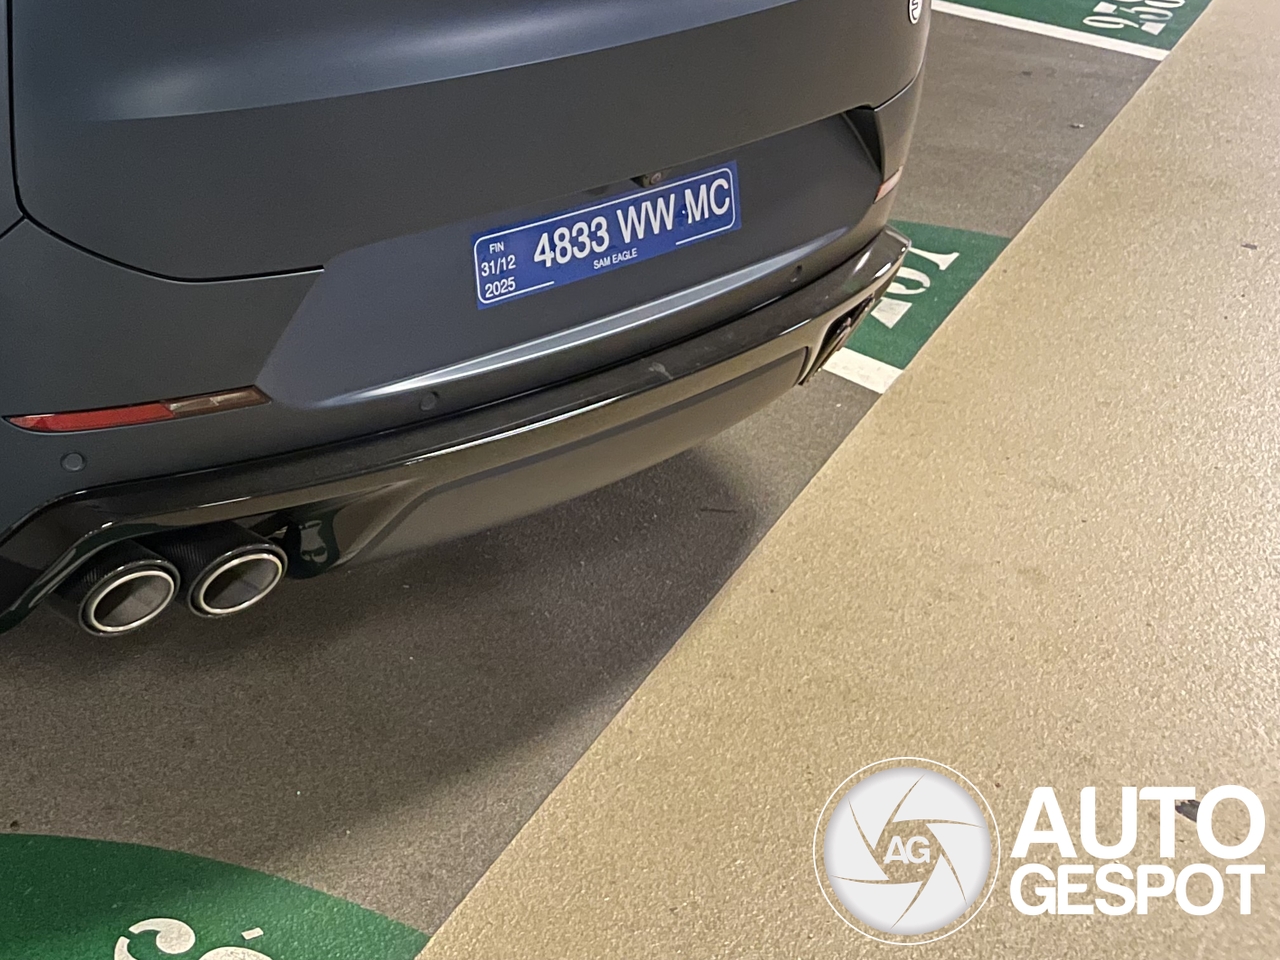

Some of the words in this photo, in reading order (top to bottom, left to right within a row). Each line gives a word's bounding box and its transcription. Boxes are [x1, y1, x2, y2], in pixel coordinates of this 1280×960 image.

[533, 215, 610, 268] 4833
[616, 193, 675, 244] WW
[684, 178, 731, 225] MC
[489, 241, 505, 254] FIN
[593, 256, 611, 269] SAM
[612, 247, 638, 264] EAGLE
[481, 254, 516, 277] 31/12
[484, 276, 516, 298] 2025
